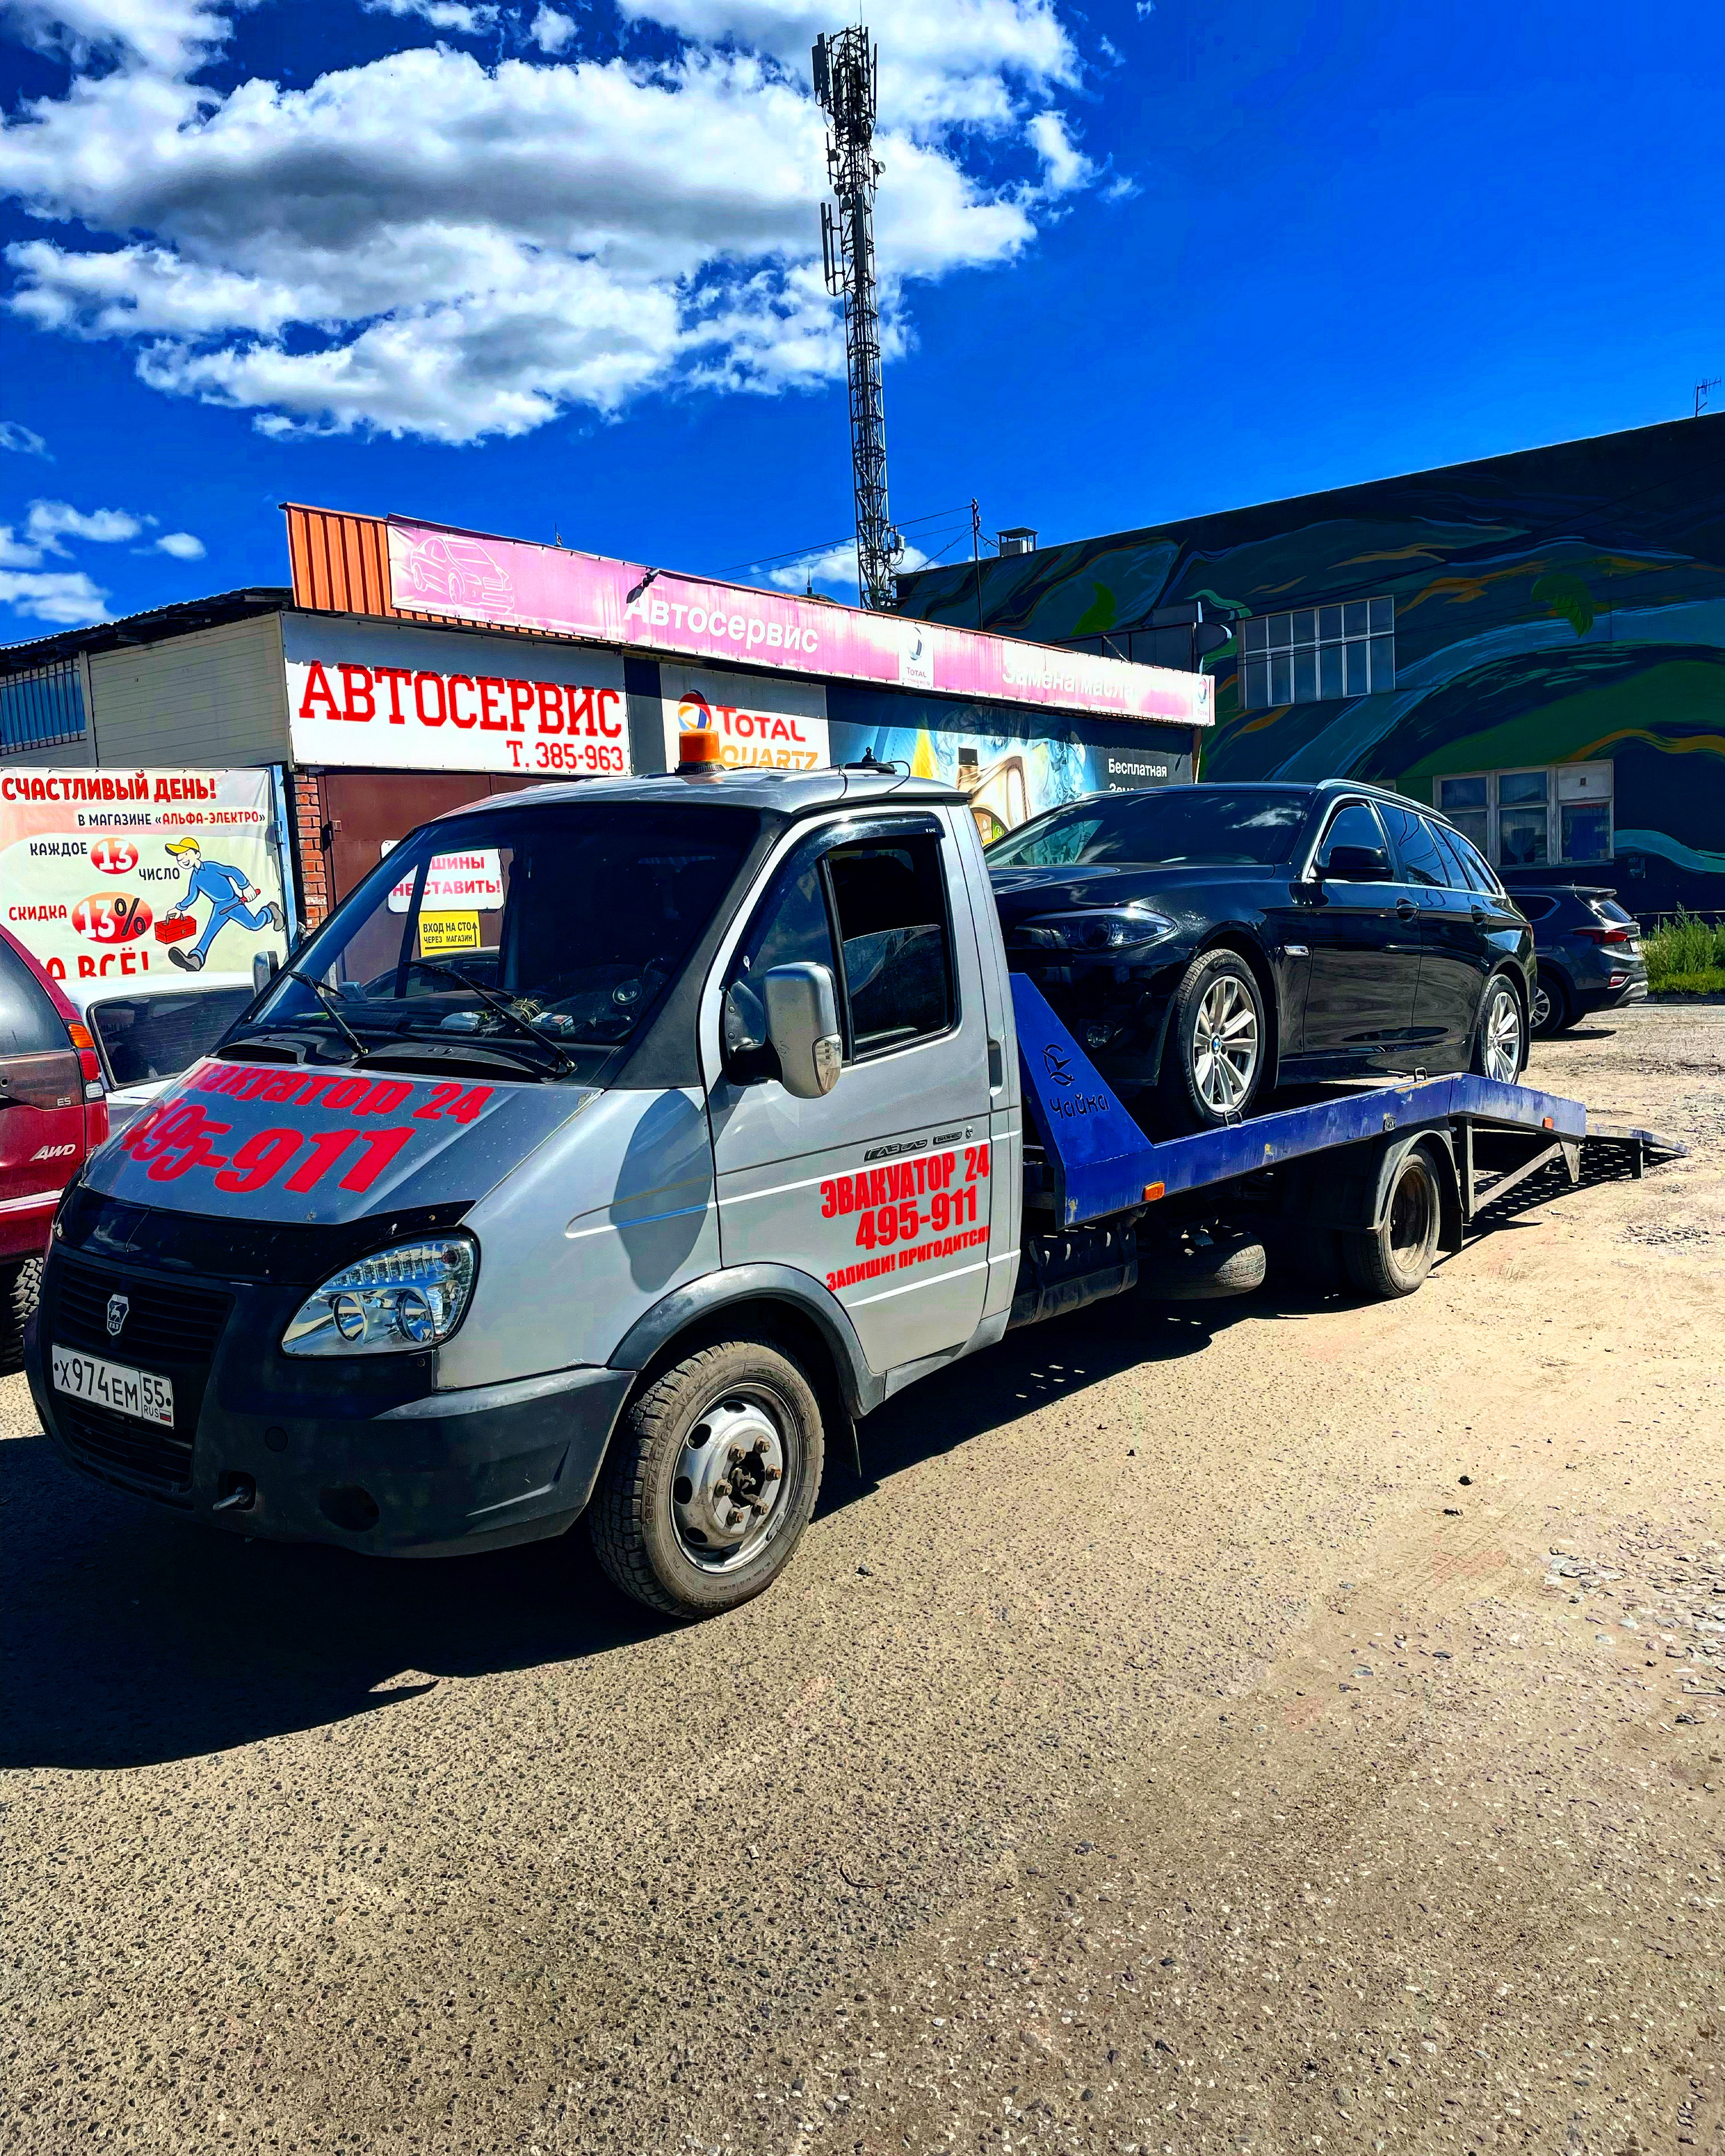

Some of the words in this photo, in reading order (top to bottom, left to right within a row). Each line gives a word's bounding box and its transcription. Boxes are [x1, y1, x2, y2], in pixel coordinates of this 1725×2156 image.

[623, 592, 819, 653] Автосервис
[906, 667, 927, 678] TOTAL
[1002, 664, 1076, 692] Замена
[1080, 674, 1135, 699] масла
[299, 659, 622, 738] АВТОСЕРВИС
[716, 706, 806, 743] TOTAL
[536, 741, 623, 771] 385-963
[720, 745, 818, 770] QUARTZ
[1108, 758, 1167, 777] Бесплатная
[1, 773, 152, 801] СЧАСТЛИВЫЙ
[153, 777, 216, 803] ДЕНЬ!
[78, 816, 86, 826] В
[89, 813, 152, 826] МАГАЗИНЕ
[155, 810, 265, 825] «АЛЬФА-ЭЛЕКТРО»
[30, 842, 88, 856] КАЖДОЕ
[98, 837, 134, 870] 13
[138, 867, 180, 881] ЧИСЛО
[429, 857, 484, 870] ШИНЫ
[392, 883, 414, 897] НЕ
[423, 880, 500, 895] СТАВИТЬ!
[9, 905, 67, 921] СКИДКА
[78, 897, 146, 939] 13%
[423, 922, 444, 934] ВХОД
[446, 922, 456, 932] НА
[457, 921, 471, 931] СТО
[446, 934, 472, 943] МАГАЗИН
[57, 1097, 71, 1107] ES
[412, 1083, 495, 1124] 24
[1049, 1093, 1109, 1120] Чайка
[29, 1143, 76, 1162] AWD
[119, 1097, 416, 1194] 495-911
[820, 1152, 956, 1219] ЭВАКУАТОР
[964, 1144, 990, 1183] 24
[856, 1185, 977, 1250] 495-911
[826, 1254, 896, 1291] ЗАПИШИ!
[898, 1225, 990, 1269] ПРИГОДИТСЯ!
[59, 1358, 139, 1411] Х974ЕМ
[143, 1377, 165, 1408] 55
[143, 1404, 160, 1418] RUS
